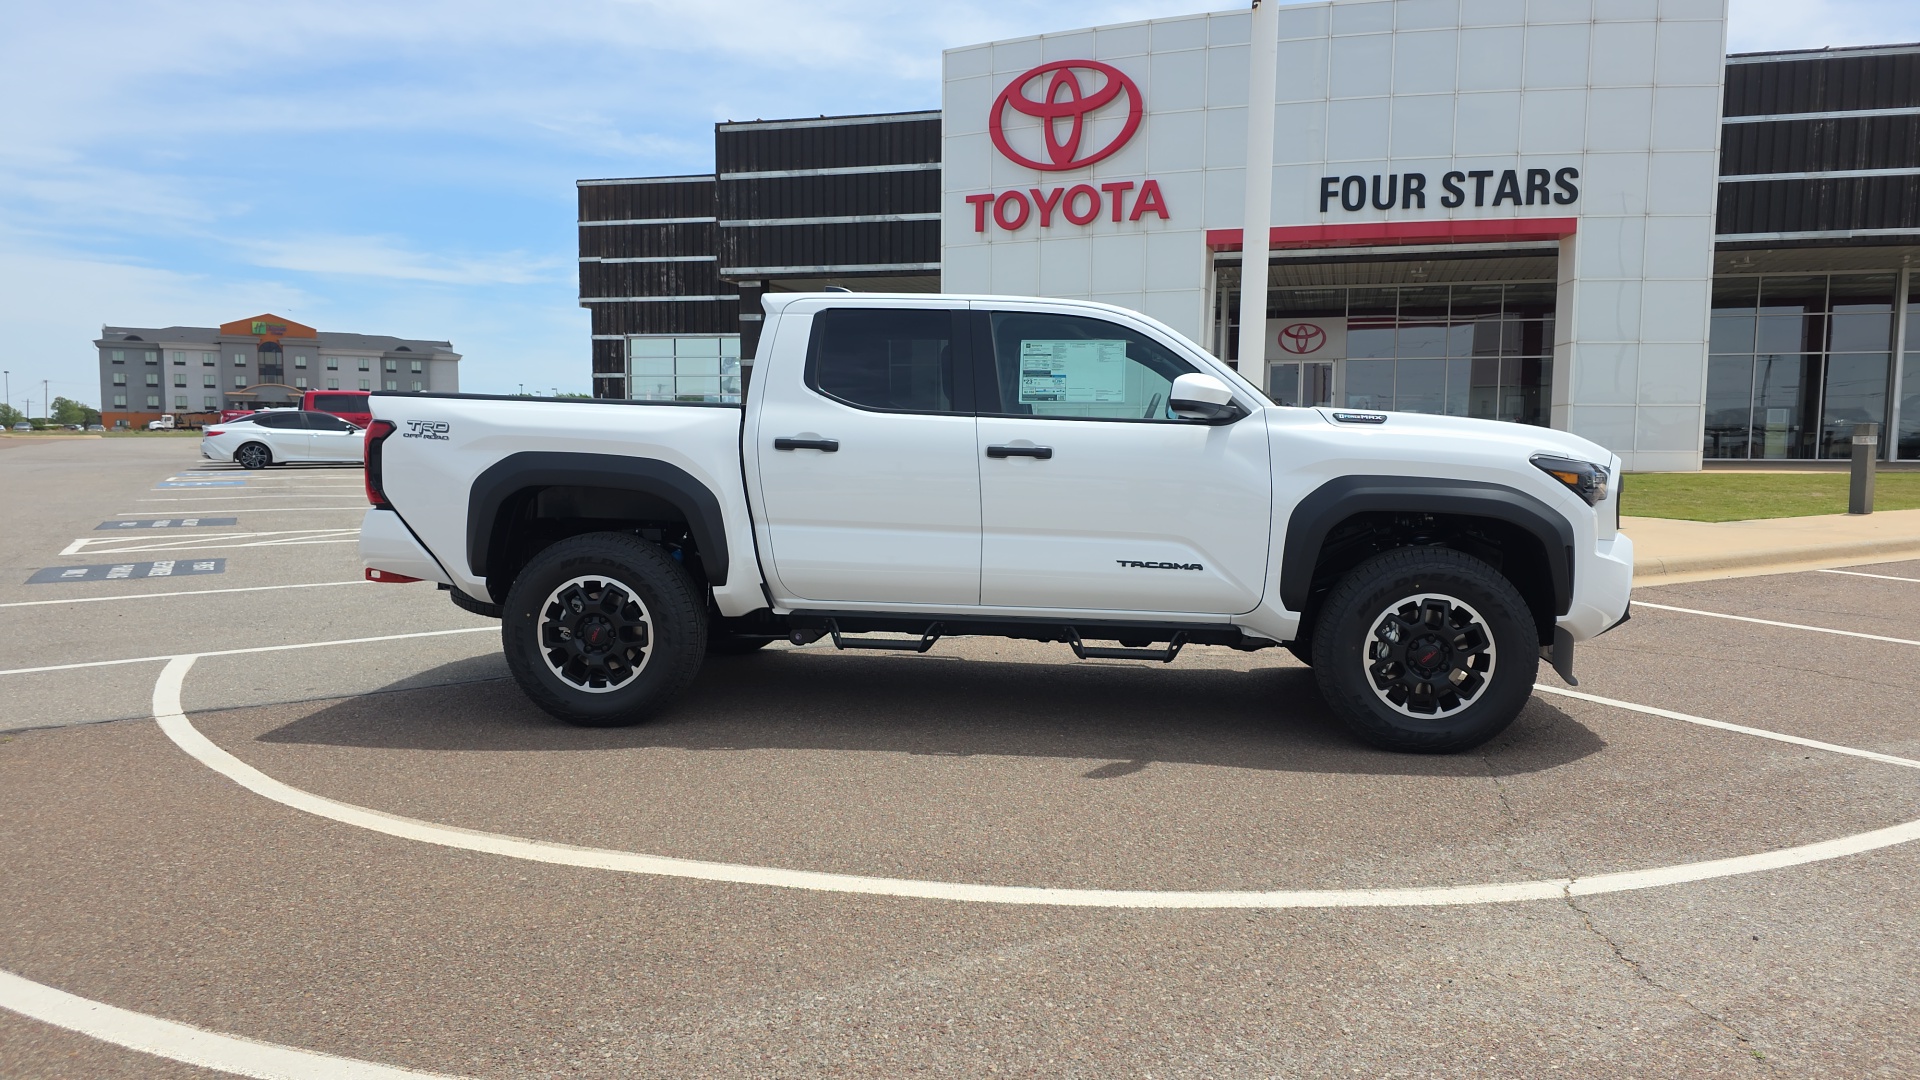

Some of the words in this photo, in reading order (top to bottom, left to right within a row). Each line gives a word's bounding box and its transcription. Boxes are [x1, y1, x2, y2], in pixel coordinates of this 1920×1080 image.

[1319, 172, 1427, 213] FOUR
[1440, 166, 1580, 209] STARS
[966, 179, 1170, 233] TOYOTA
[406, 420, 450, 435] TRD
[1116, 560, 1204, 571] TACOMA
